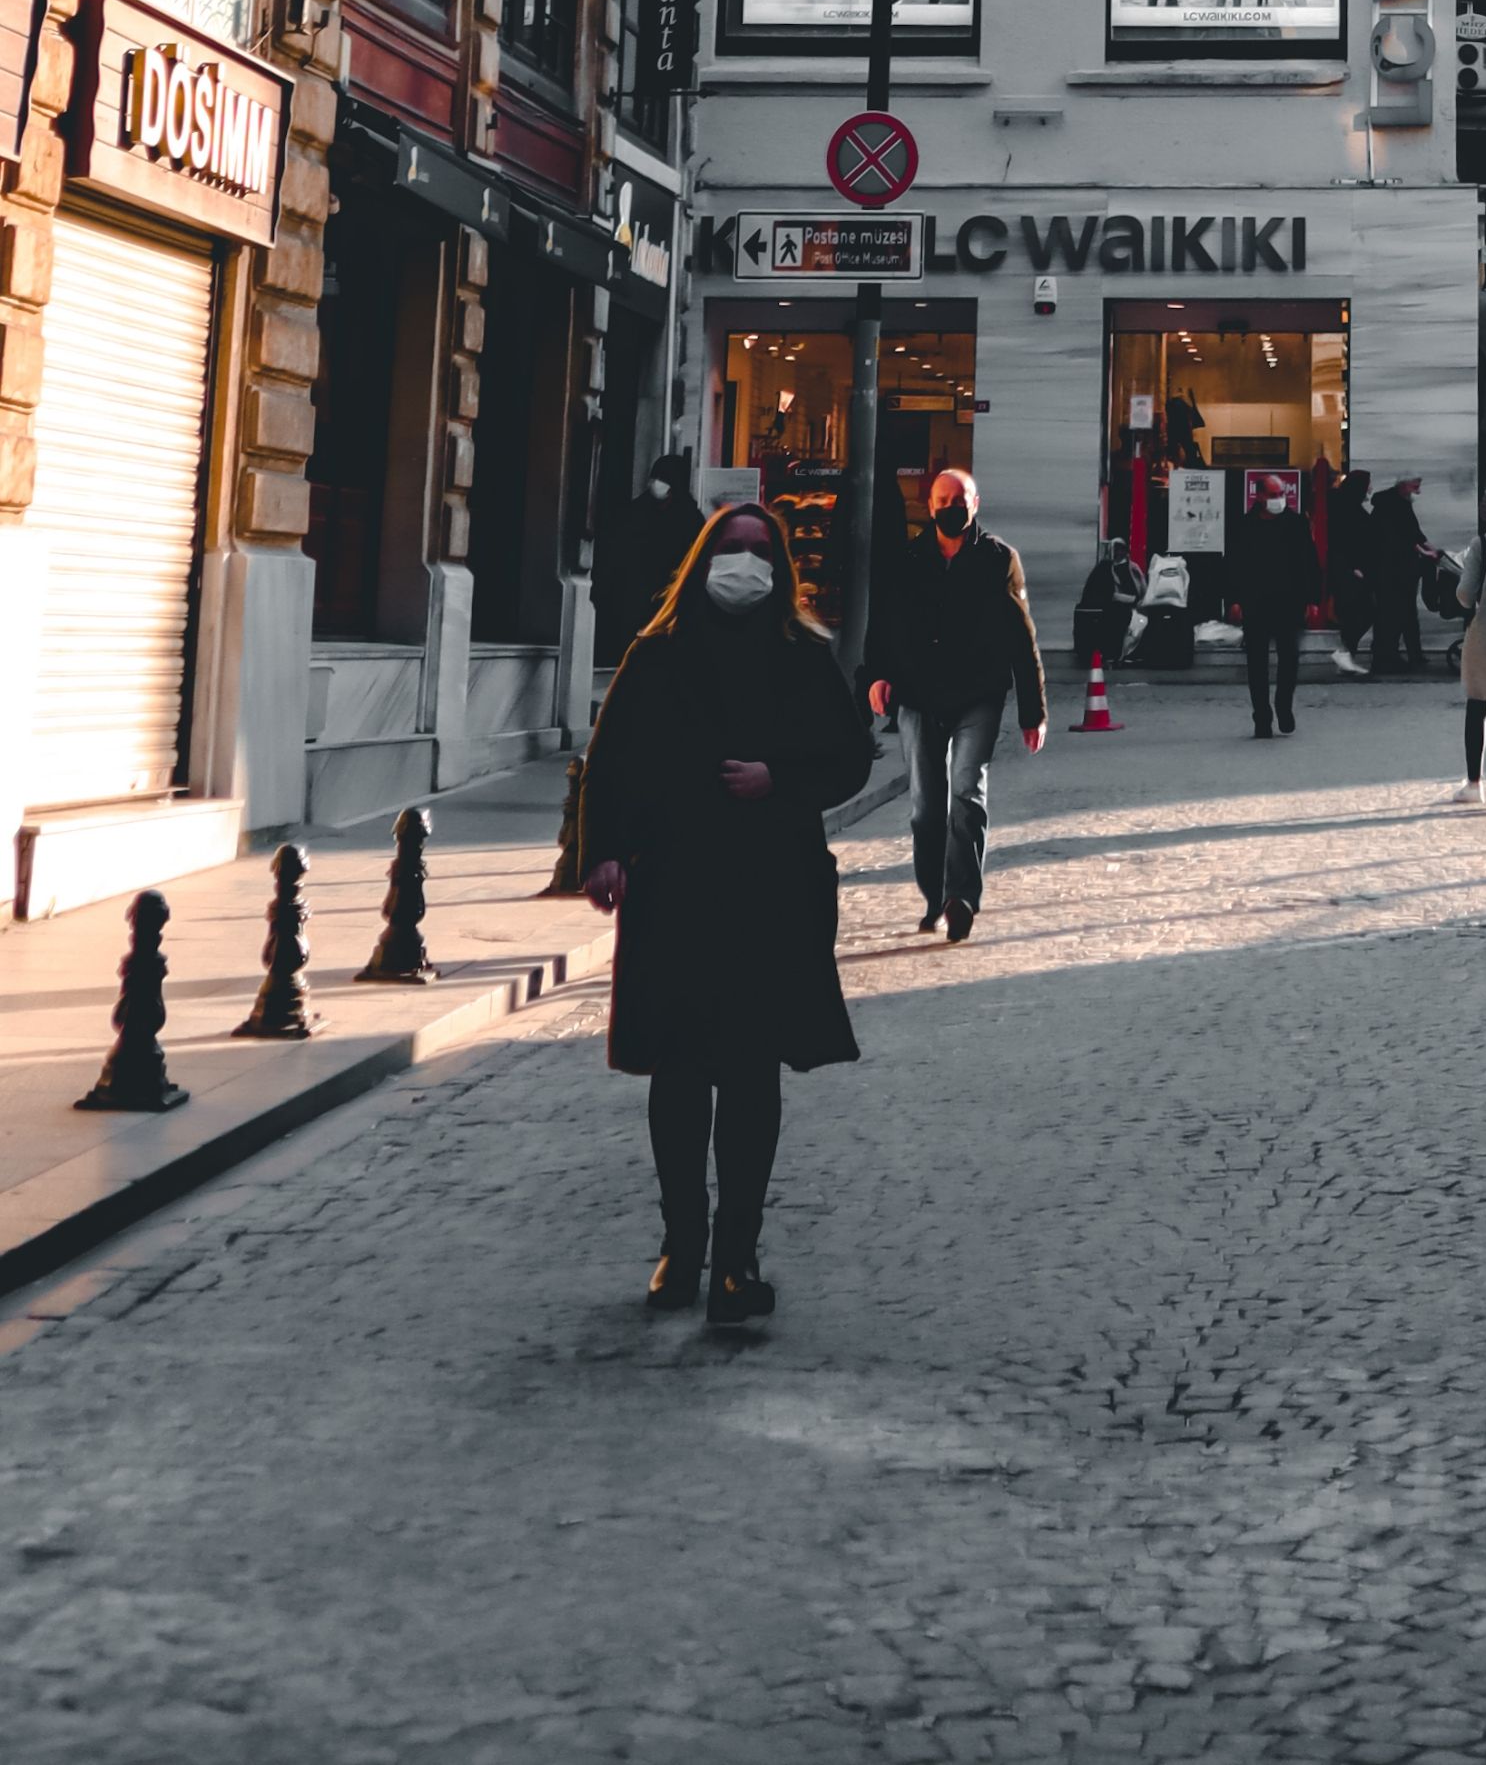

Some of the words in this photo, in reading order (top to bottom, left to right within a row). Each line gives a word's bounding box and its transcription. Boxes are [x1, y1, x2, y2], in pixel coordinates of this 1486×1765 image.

[1370, 14, 1436, 127] LC
[138, 41, 273, 195] DÖSİMM
[804, 226, 857, 244] Postane
[860, 227, 908, 245] müzesi
[925, 214, 1009, 273] LC
